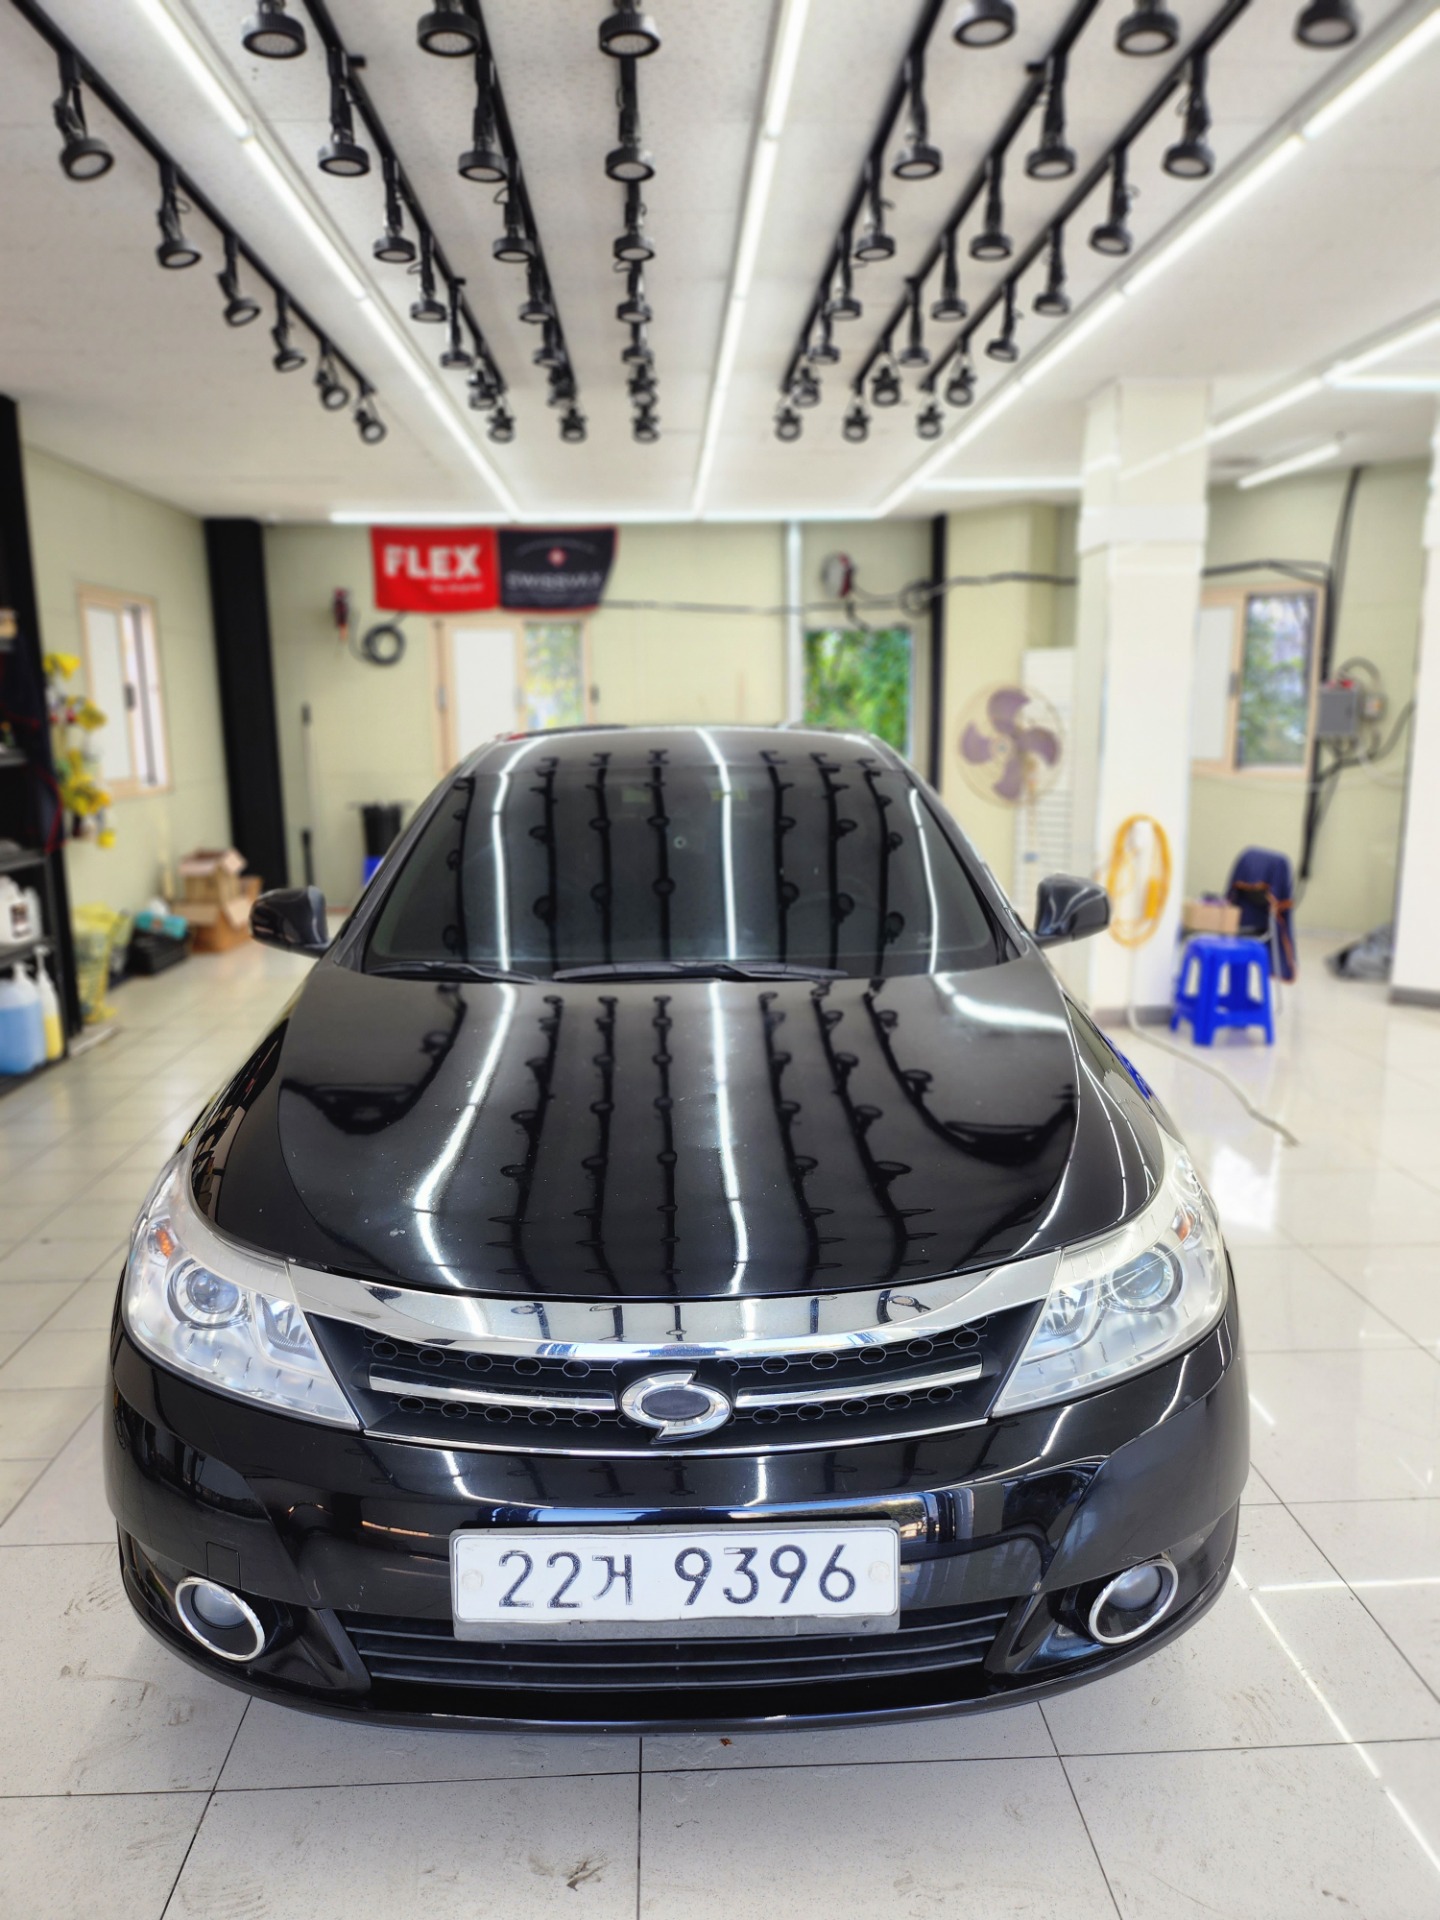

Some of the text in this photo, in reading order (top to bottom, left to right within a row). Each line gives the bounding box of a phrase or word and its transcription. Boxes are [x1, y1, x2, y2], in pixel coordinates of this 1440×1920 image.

[384, 544, 481, 579] FLEX
[499, 1544, 857, 1608] 22거 9396
